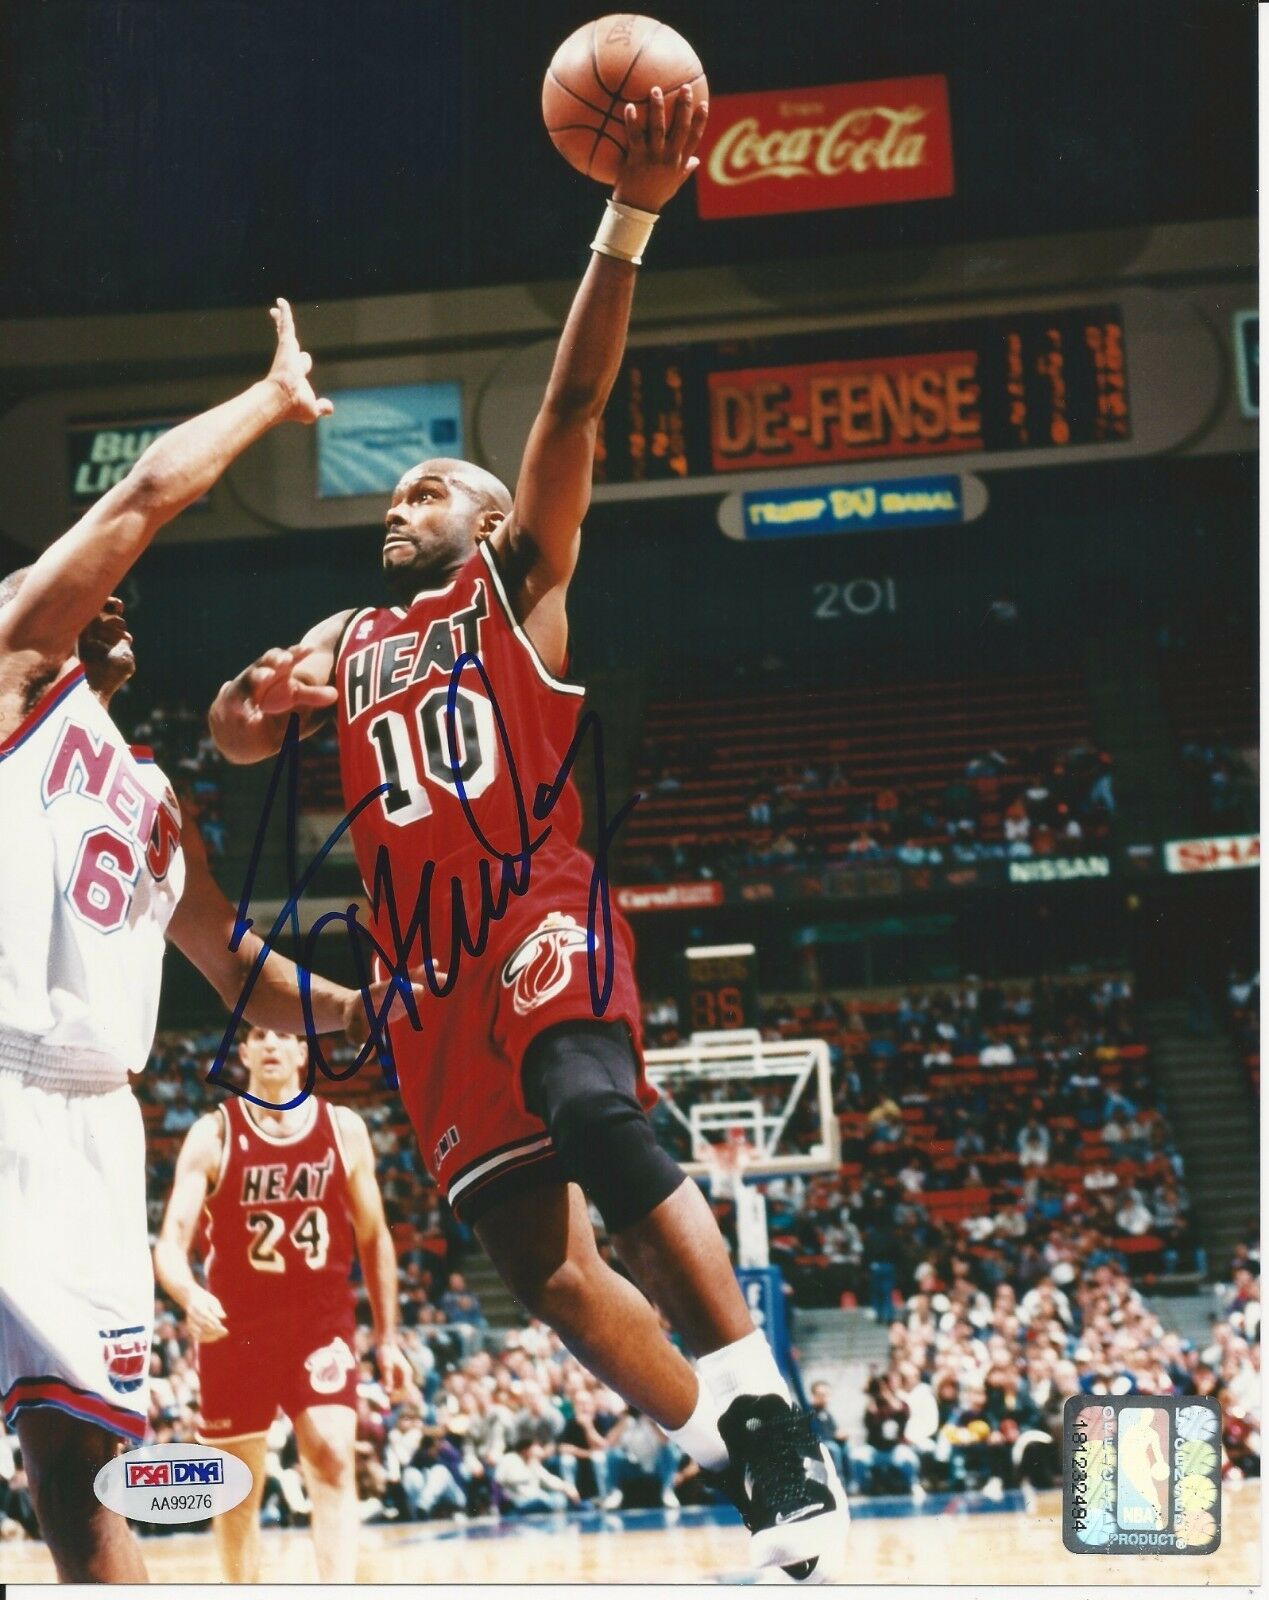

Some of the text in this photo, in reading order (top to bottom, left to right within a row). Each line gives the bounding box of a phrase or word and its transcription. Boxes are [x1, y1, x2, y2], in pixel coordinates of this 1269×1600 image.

[708, 106, 930, 186] Coca-Cola
[91, 431, 168, 463] BU
[812, 577, 897, 618] 201
[346, 578, 490, 725] HEAT
[367, 684, 499, 827] 10
[41, 717, 181, 882] NETS
[64, 825, 141, 935] 6
[1008, 856, 1110, 883] NISSAN
[240, 1147, 335, 1206] HEAT
[246, 1206, 330, 1273] 24
[129, 1461, 219, 1486] PSA DNA
[150, 1493, 213, 1511] AA99276
[1109, 1533, 1175, 1546] PRODUCT
